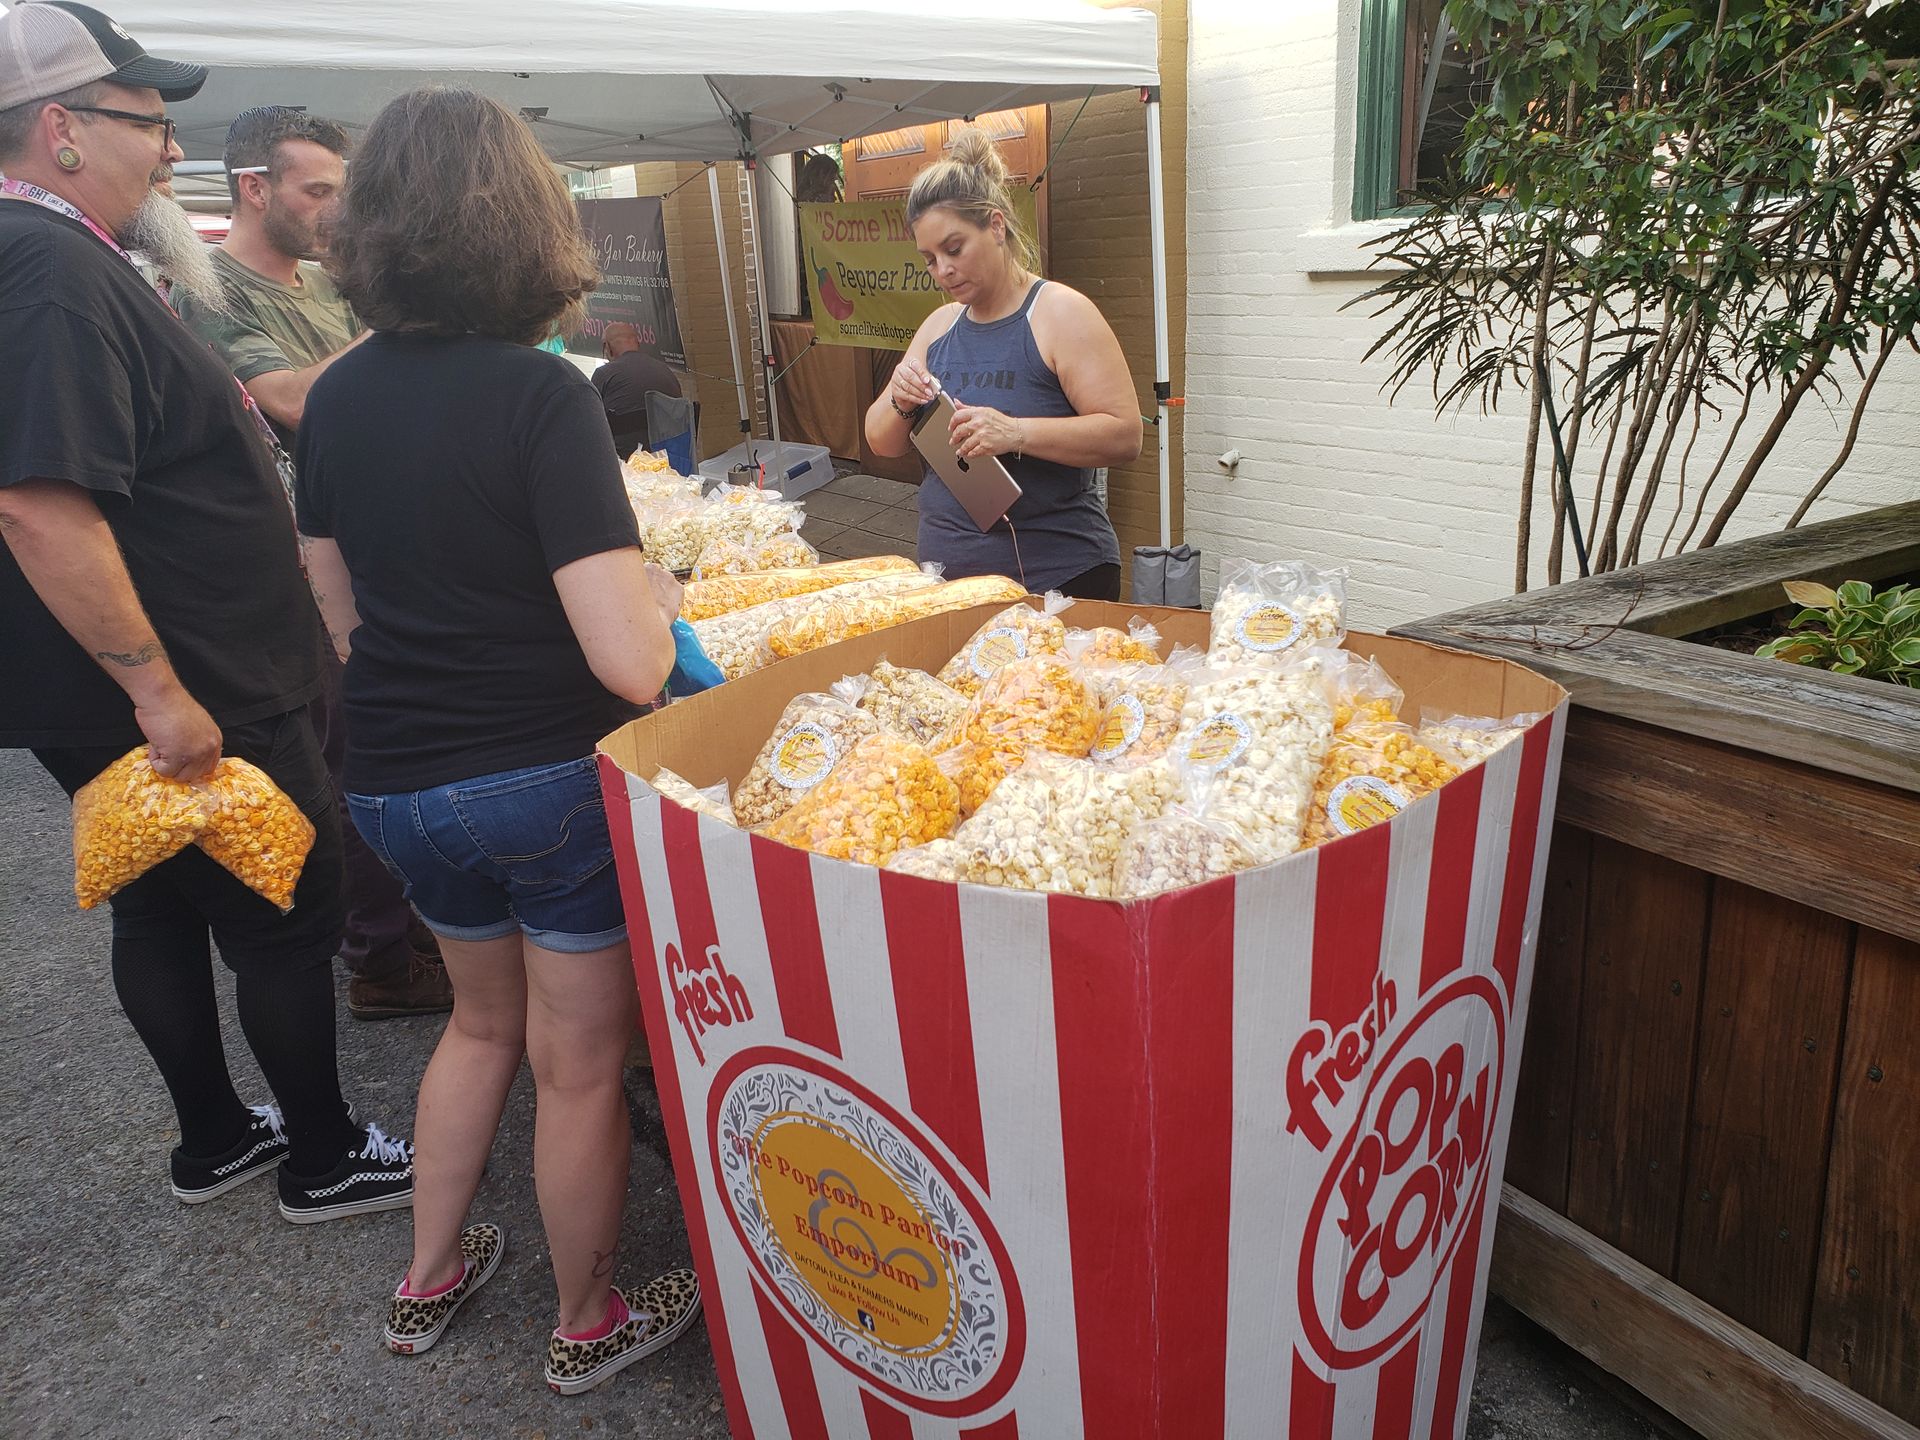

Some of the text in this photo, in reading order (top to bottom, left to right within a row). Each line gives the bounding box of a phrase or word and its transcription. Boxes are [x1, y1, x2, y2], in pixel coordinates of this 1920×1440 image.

[604, 234, 622, 270] Jar
[626, 235, 664, 274] Bakery
[836, 261, 898, 296] Pepper
[956, 370, 1016, 395] you
[665, 943, 754, 1067] fresh
[1285, 971, 1397, 1152] fresh
[730, 1133, 966, 1257] The Popcorn Parlor
[793, 1213, 921, 1292] Emporium
[795, 1251, 829, 1276] DAYTONA
[829, 1272, 851, 1286] FLEA
[857, 1282, 895, 1308] FARMERS
[895, 1299, 929, 1326] MARKET
[827, 1281, 846, 1298] Like
[856, 1295, 886, 1318] Follow
[886, 1310, 900, 1326] Us
